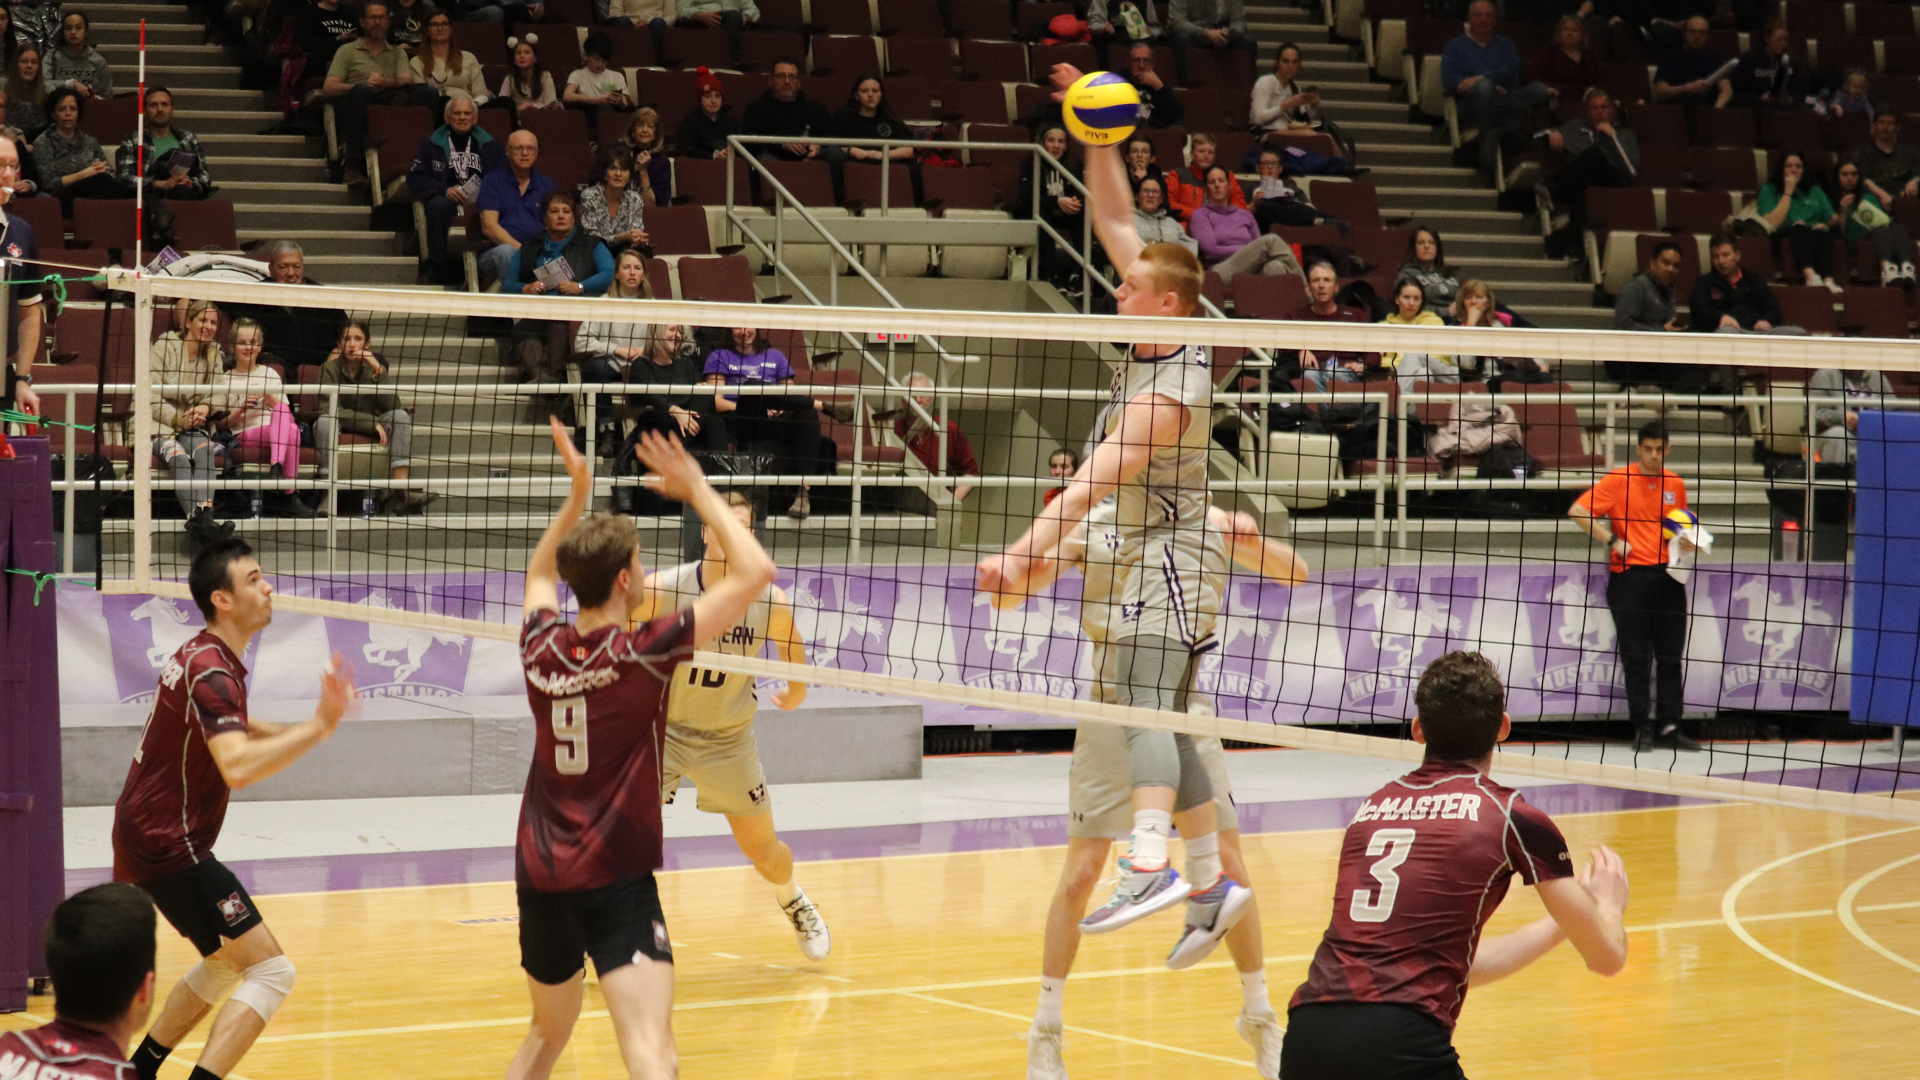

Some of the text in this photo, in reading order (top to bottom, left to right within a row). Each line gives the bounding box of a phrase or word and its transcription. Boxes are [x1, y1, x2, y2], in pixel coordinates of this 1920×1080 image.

[1724, 662, 1829, 690] MUSTANGS
[551, 695, 589, 776] 9
[1348, 792, 1482, 828] McMASTER
[1349, 827, 1417, 923] 3
